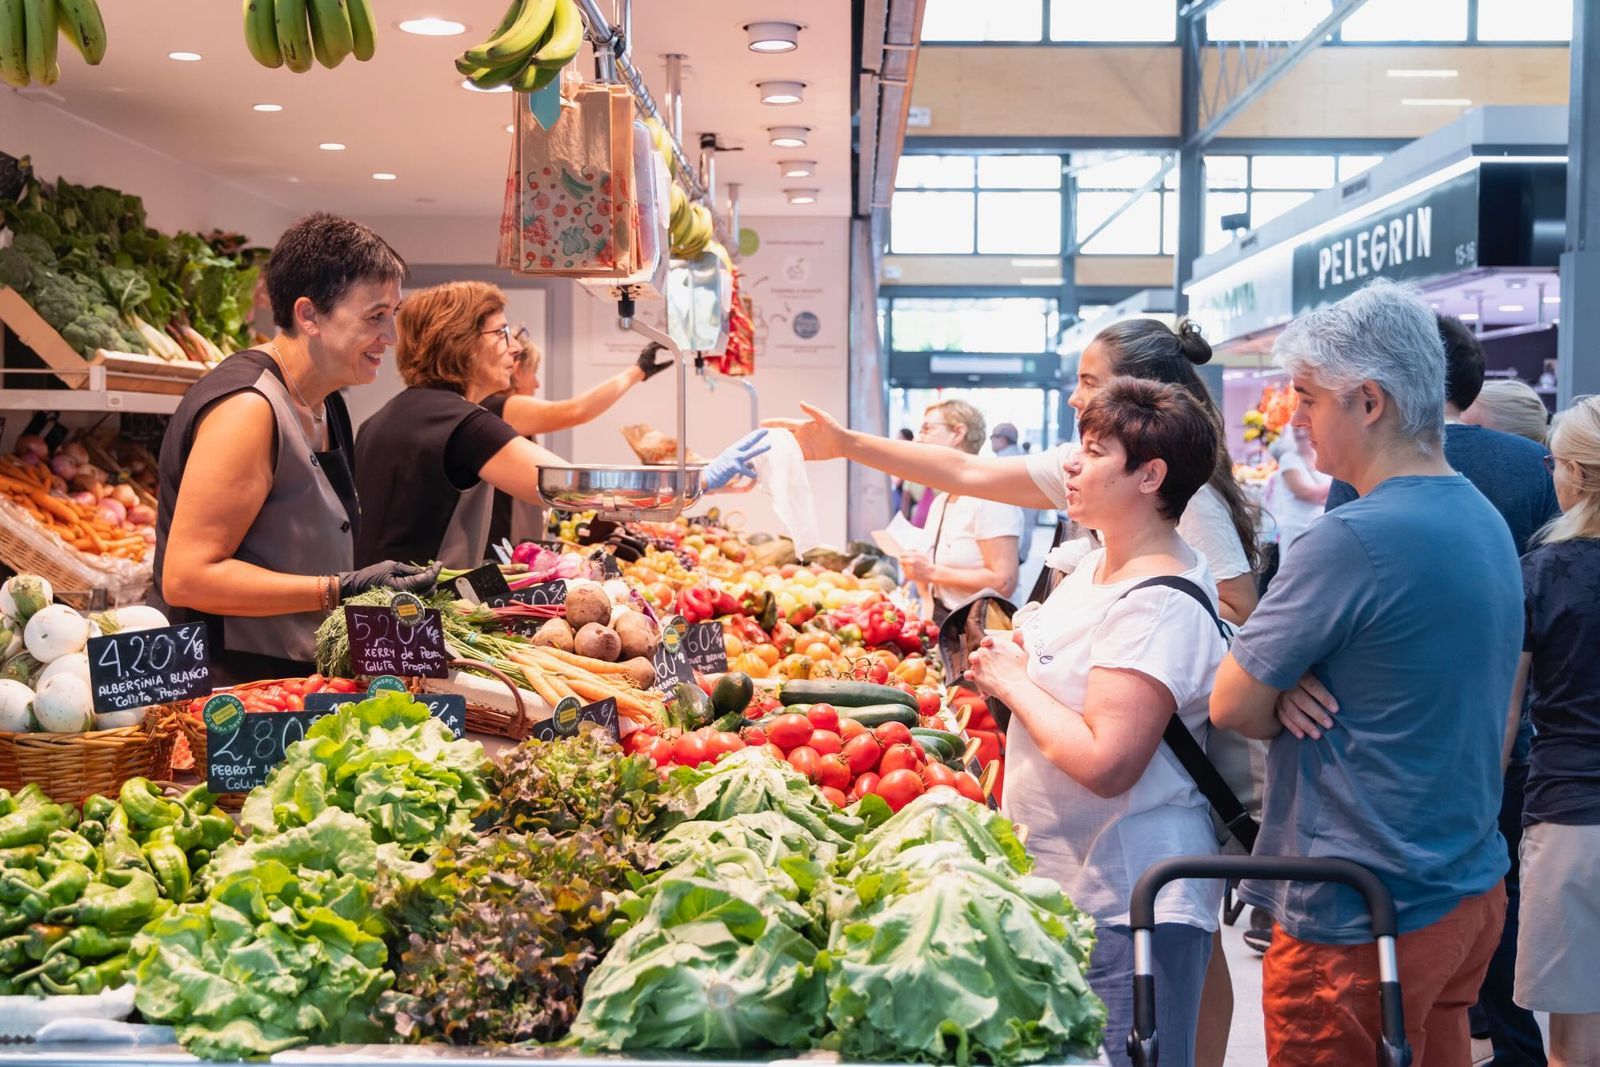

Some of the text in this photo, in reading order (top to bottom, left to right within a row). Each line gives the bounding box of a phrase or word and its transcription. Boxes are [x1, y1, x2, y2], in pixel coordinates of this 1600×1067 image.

[1319, 206, 1432, 290] PELEGRIN
[98, 634, 172, 677] 4,20
[364, 647, 396, 658] XERRY
[401, 646, 414, 660] de
[170, 667, 209, 684] BLANCA
[211, 764, 257, 776] PEBROT
